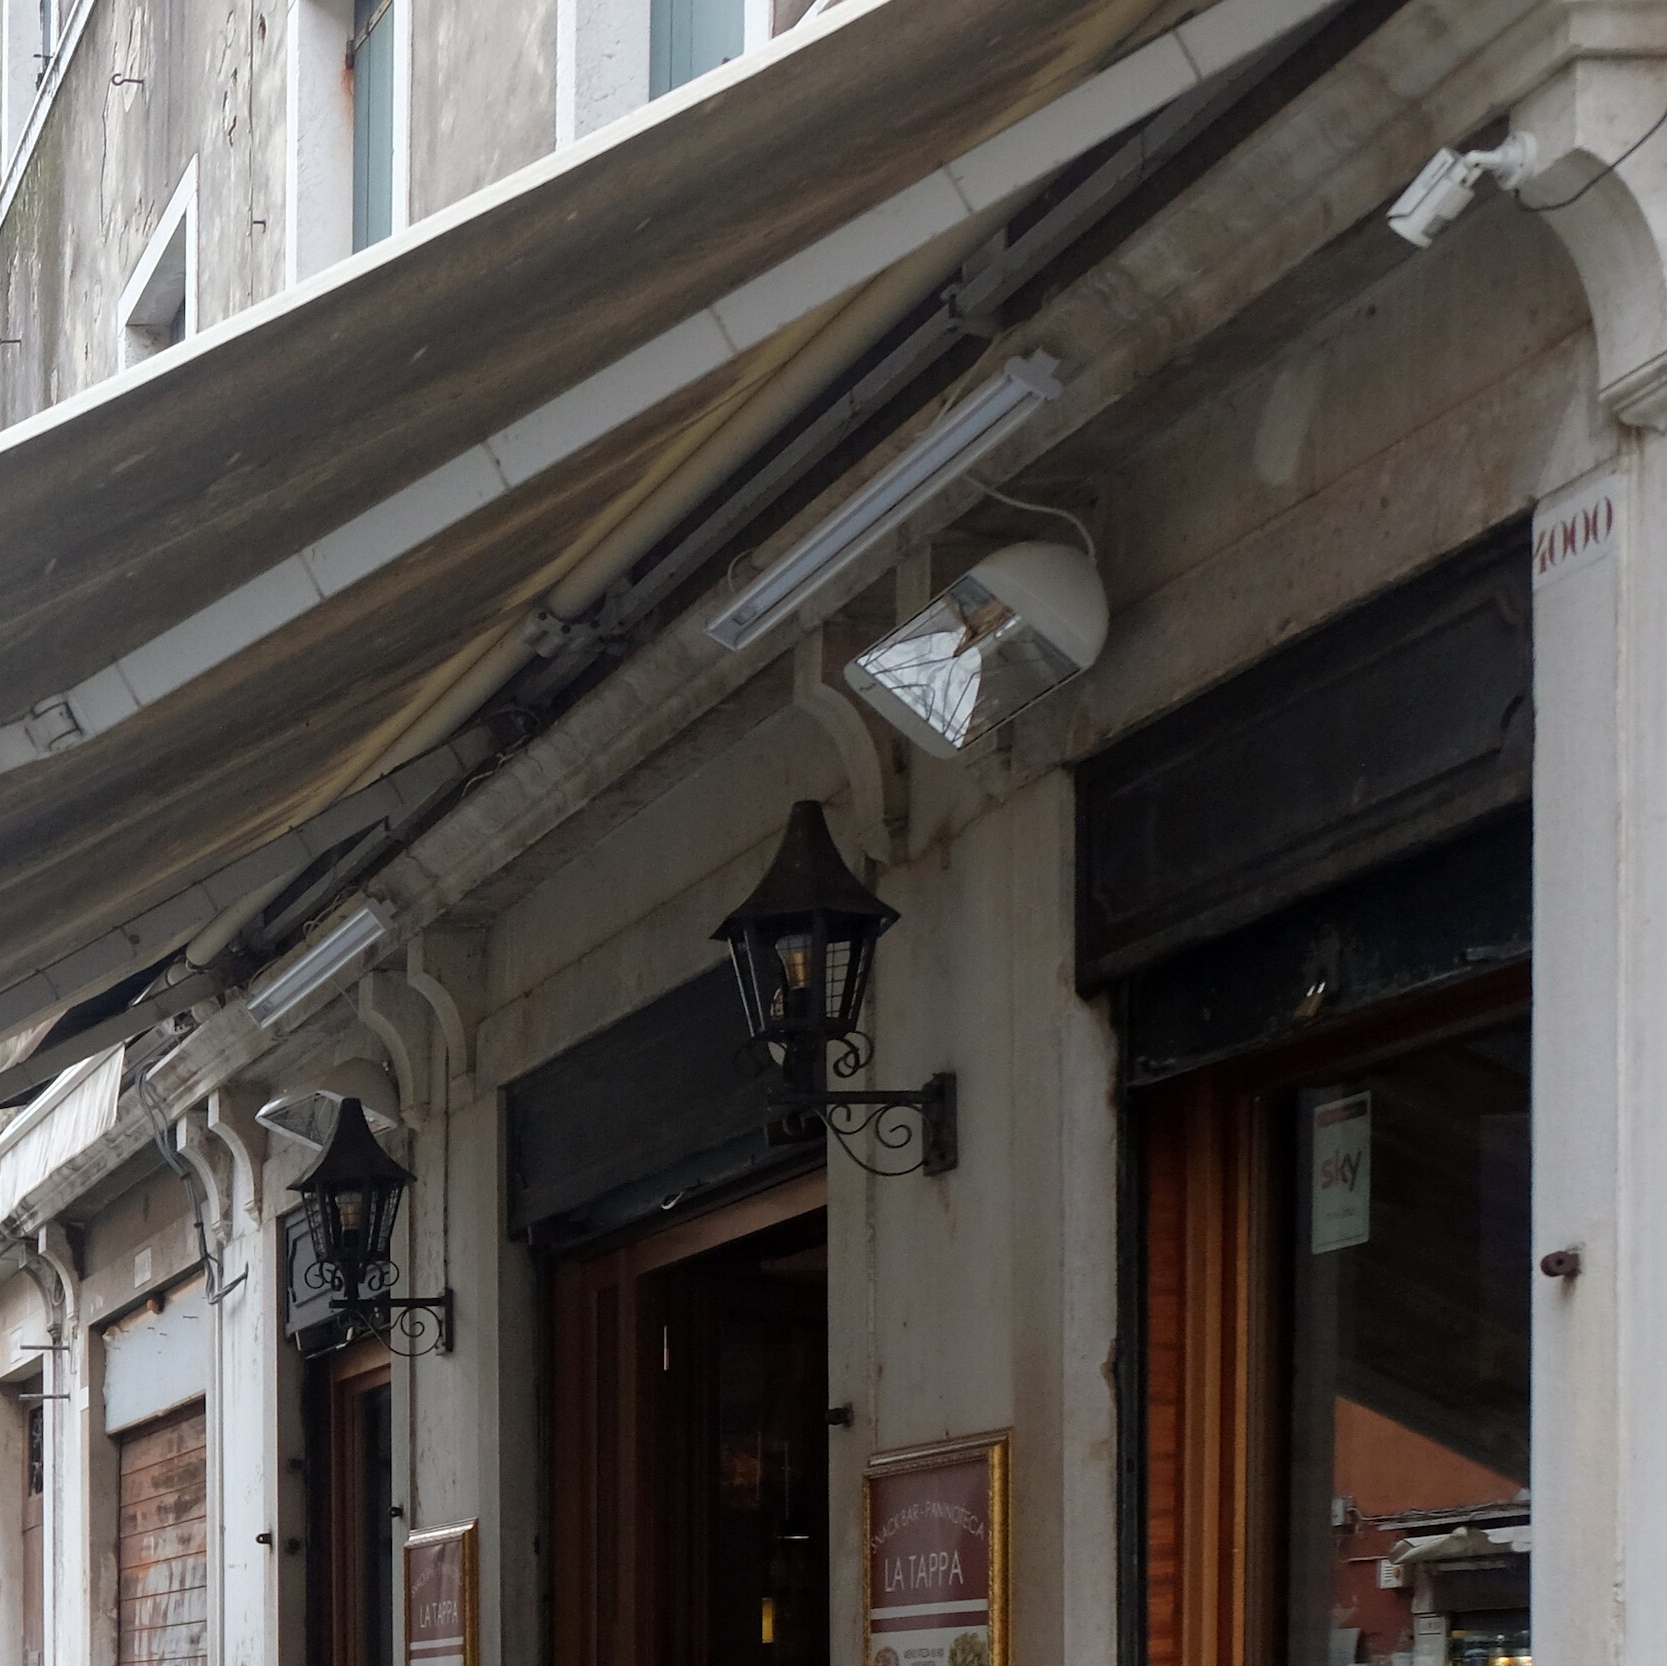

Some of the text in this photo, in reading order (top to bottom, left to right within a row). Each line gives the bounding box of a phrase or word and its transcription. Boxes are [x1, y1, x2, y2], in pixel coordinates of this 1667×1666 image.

[1321, 1149, 1362, 1192] sky
[885, 1550, 964, 1593] LA TAPPA
[420, 1600, 460, 1629] LA TAPPA
